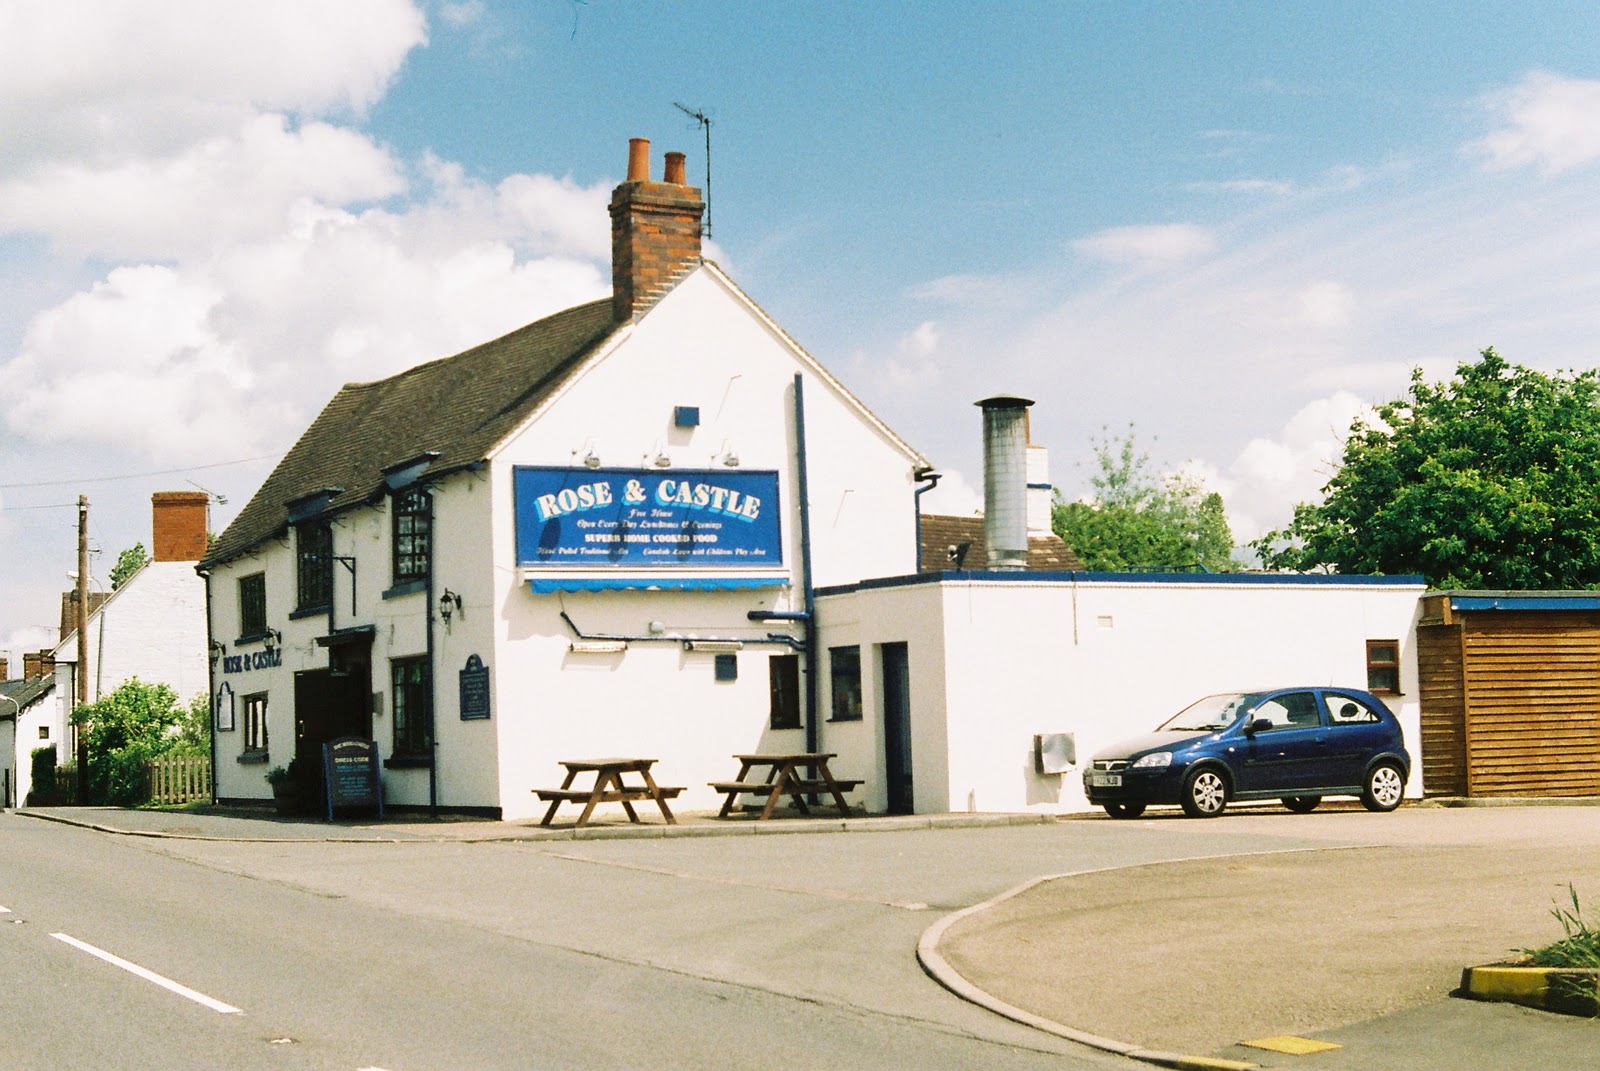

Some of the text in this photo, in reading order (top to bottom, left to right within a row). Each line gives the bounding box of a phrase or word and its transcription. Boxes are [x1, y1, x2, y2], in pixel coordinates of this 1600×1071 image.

[534, 479, 761, 522] ROSE & CASTLE
[577, 519, 596, 529] Open
[621, 520, 637, 529] Day
[584, 533, 718, 543] SUPERB HOME COOKED FOOD
